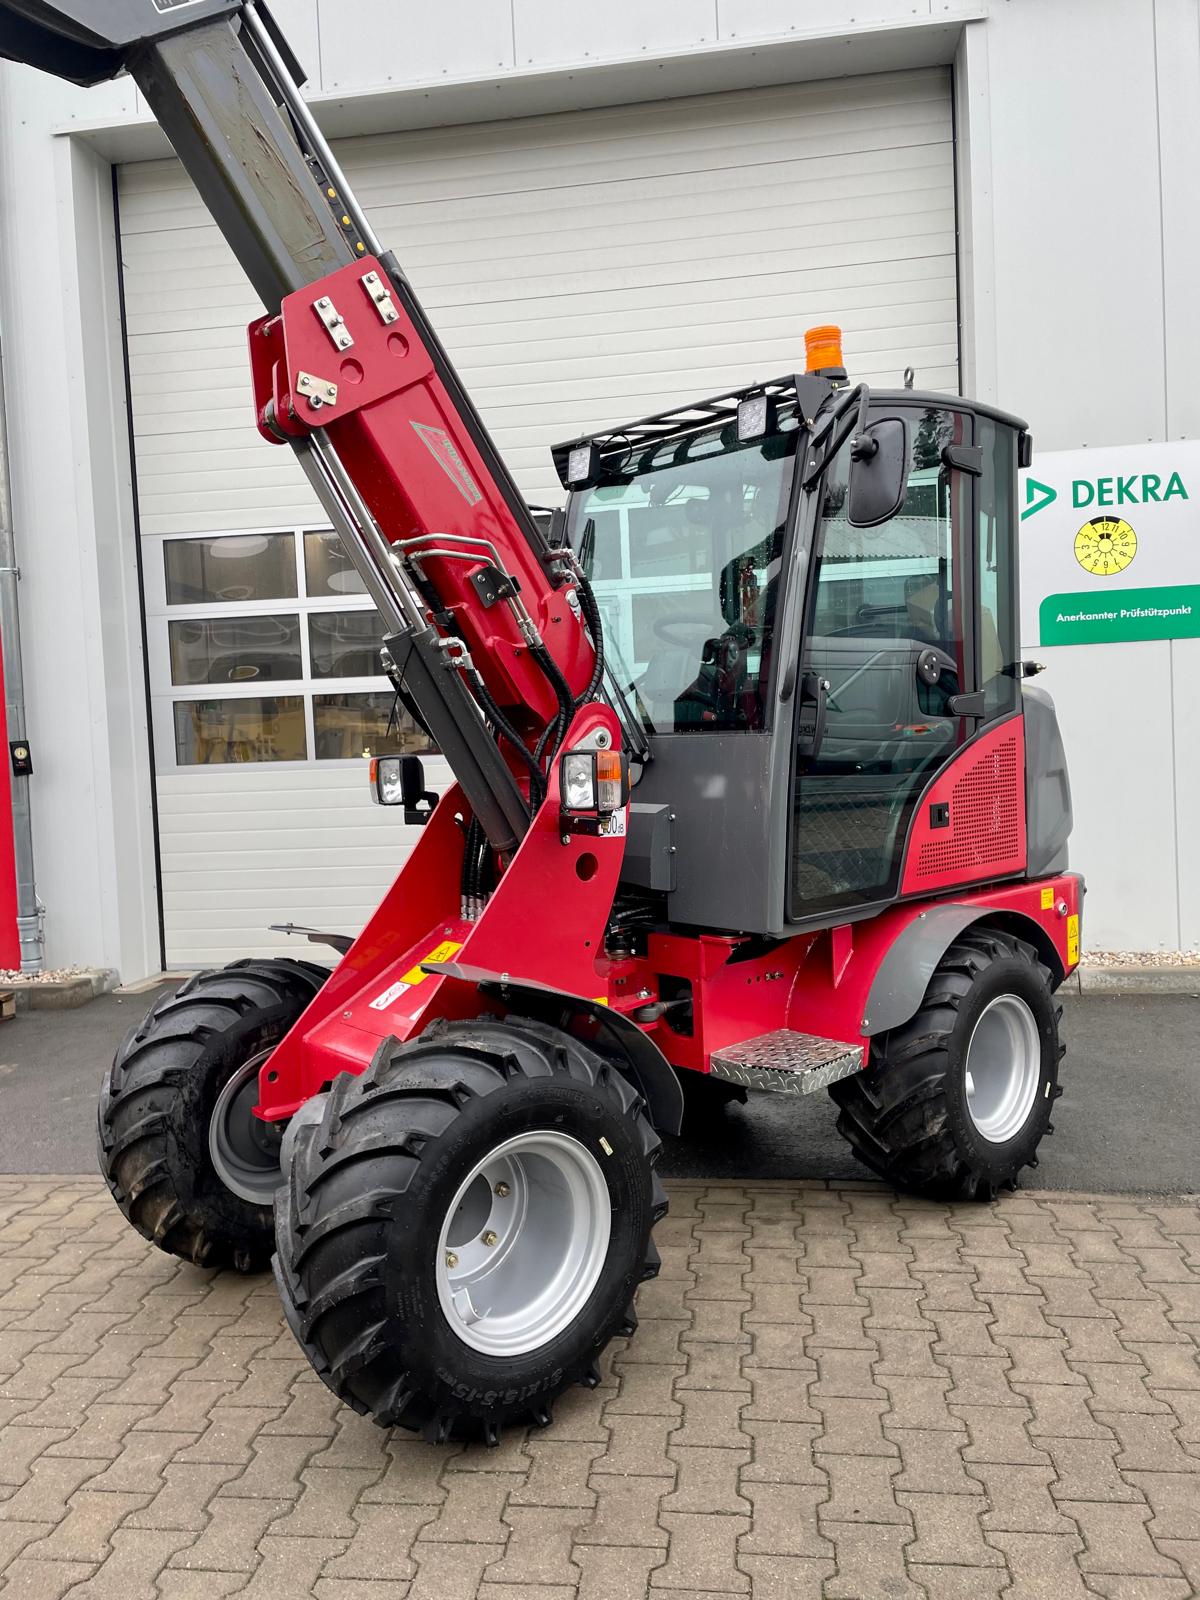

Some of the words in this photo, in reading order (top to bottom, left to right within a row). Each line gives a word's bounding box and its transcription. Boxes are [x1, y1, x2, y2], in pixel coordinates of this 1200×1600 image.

[1072, 471, 1189, 509] DEKRA
[1101, 522, 1110, 531] 12
[1111, 524, 1120, 533] 11
[1118, 530, 1129, 540] 10
[1092, 558, 1100, 567] 5
[1103, 560, 1109, 569] 6
[1056, 612, 1118, 622] Anerkannter
[1120, 605, 1192, 618] Prüfstützpunkt
